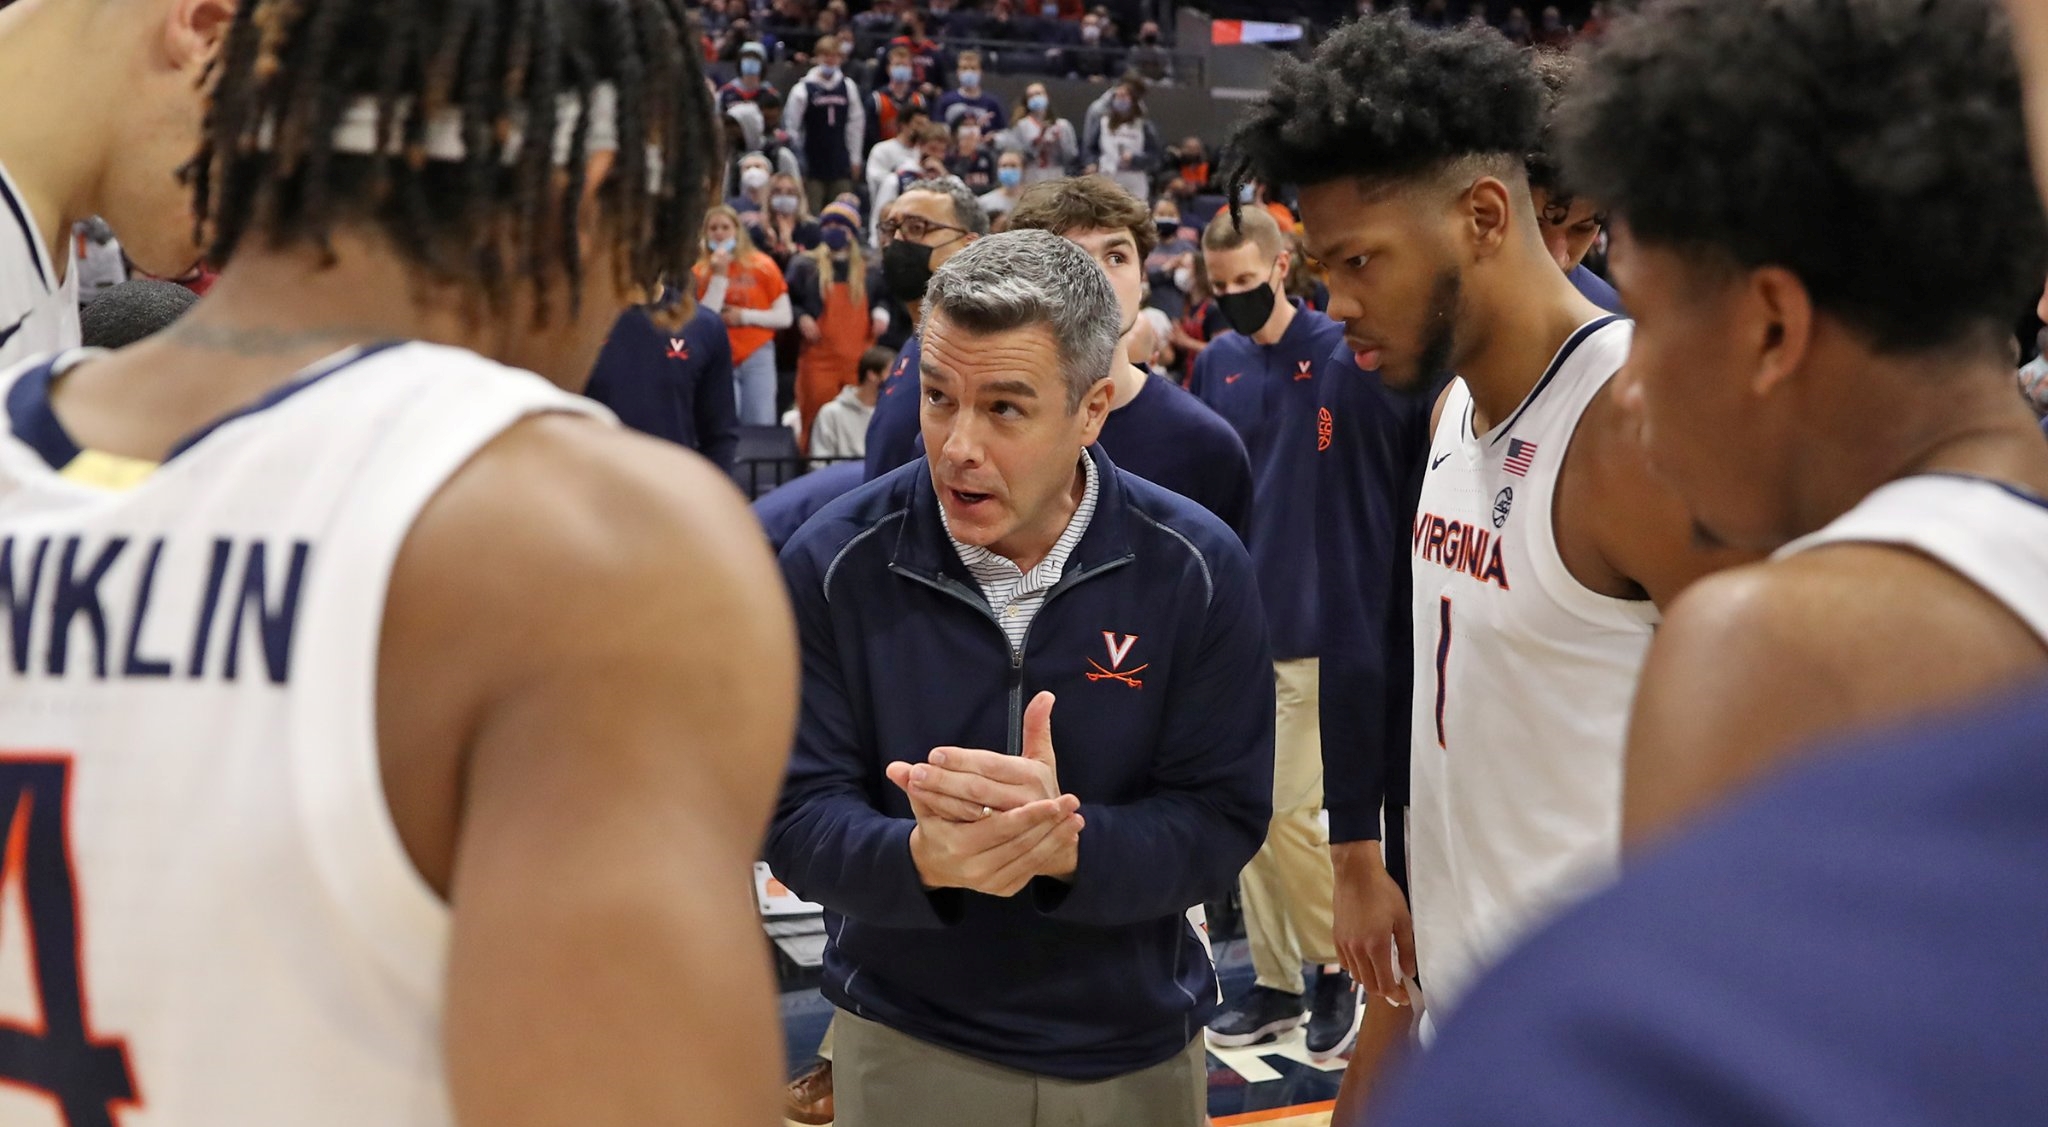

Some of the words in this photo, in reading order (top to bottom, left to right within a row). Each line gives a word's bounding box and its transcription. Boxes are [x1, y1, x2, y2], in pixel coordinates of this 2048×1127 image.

[1412, 512, 1510, 591] VIRGINIA
[1101, 630, 1139, 670] V
[1435, 595, 1452, 751] 1
